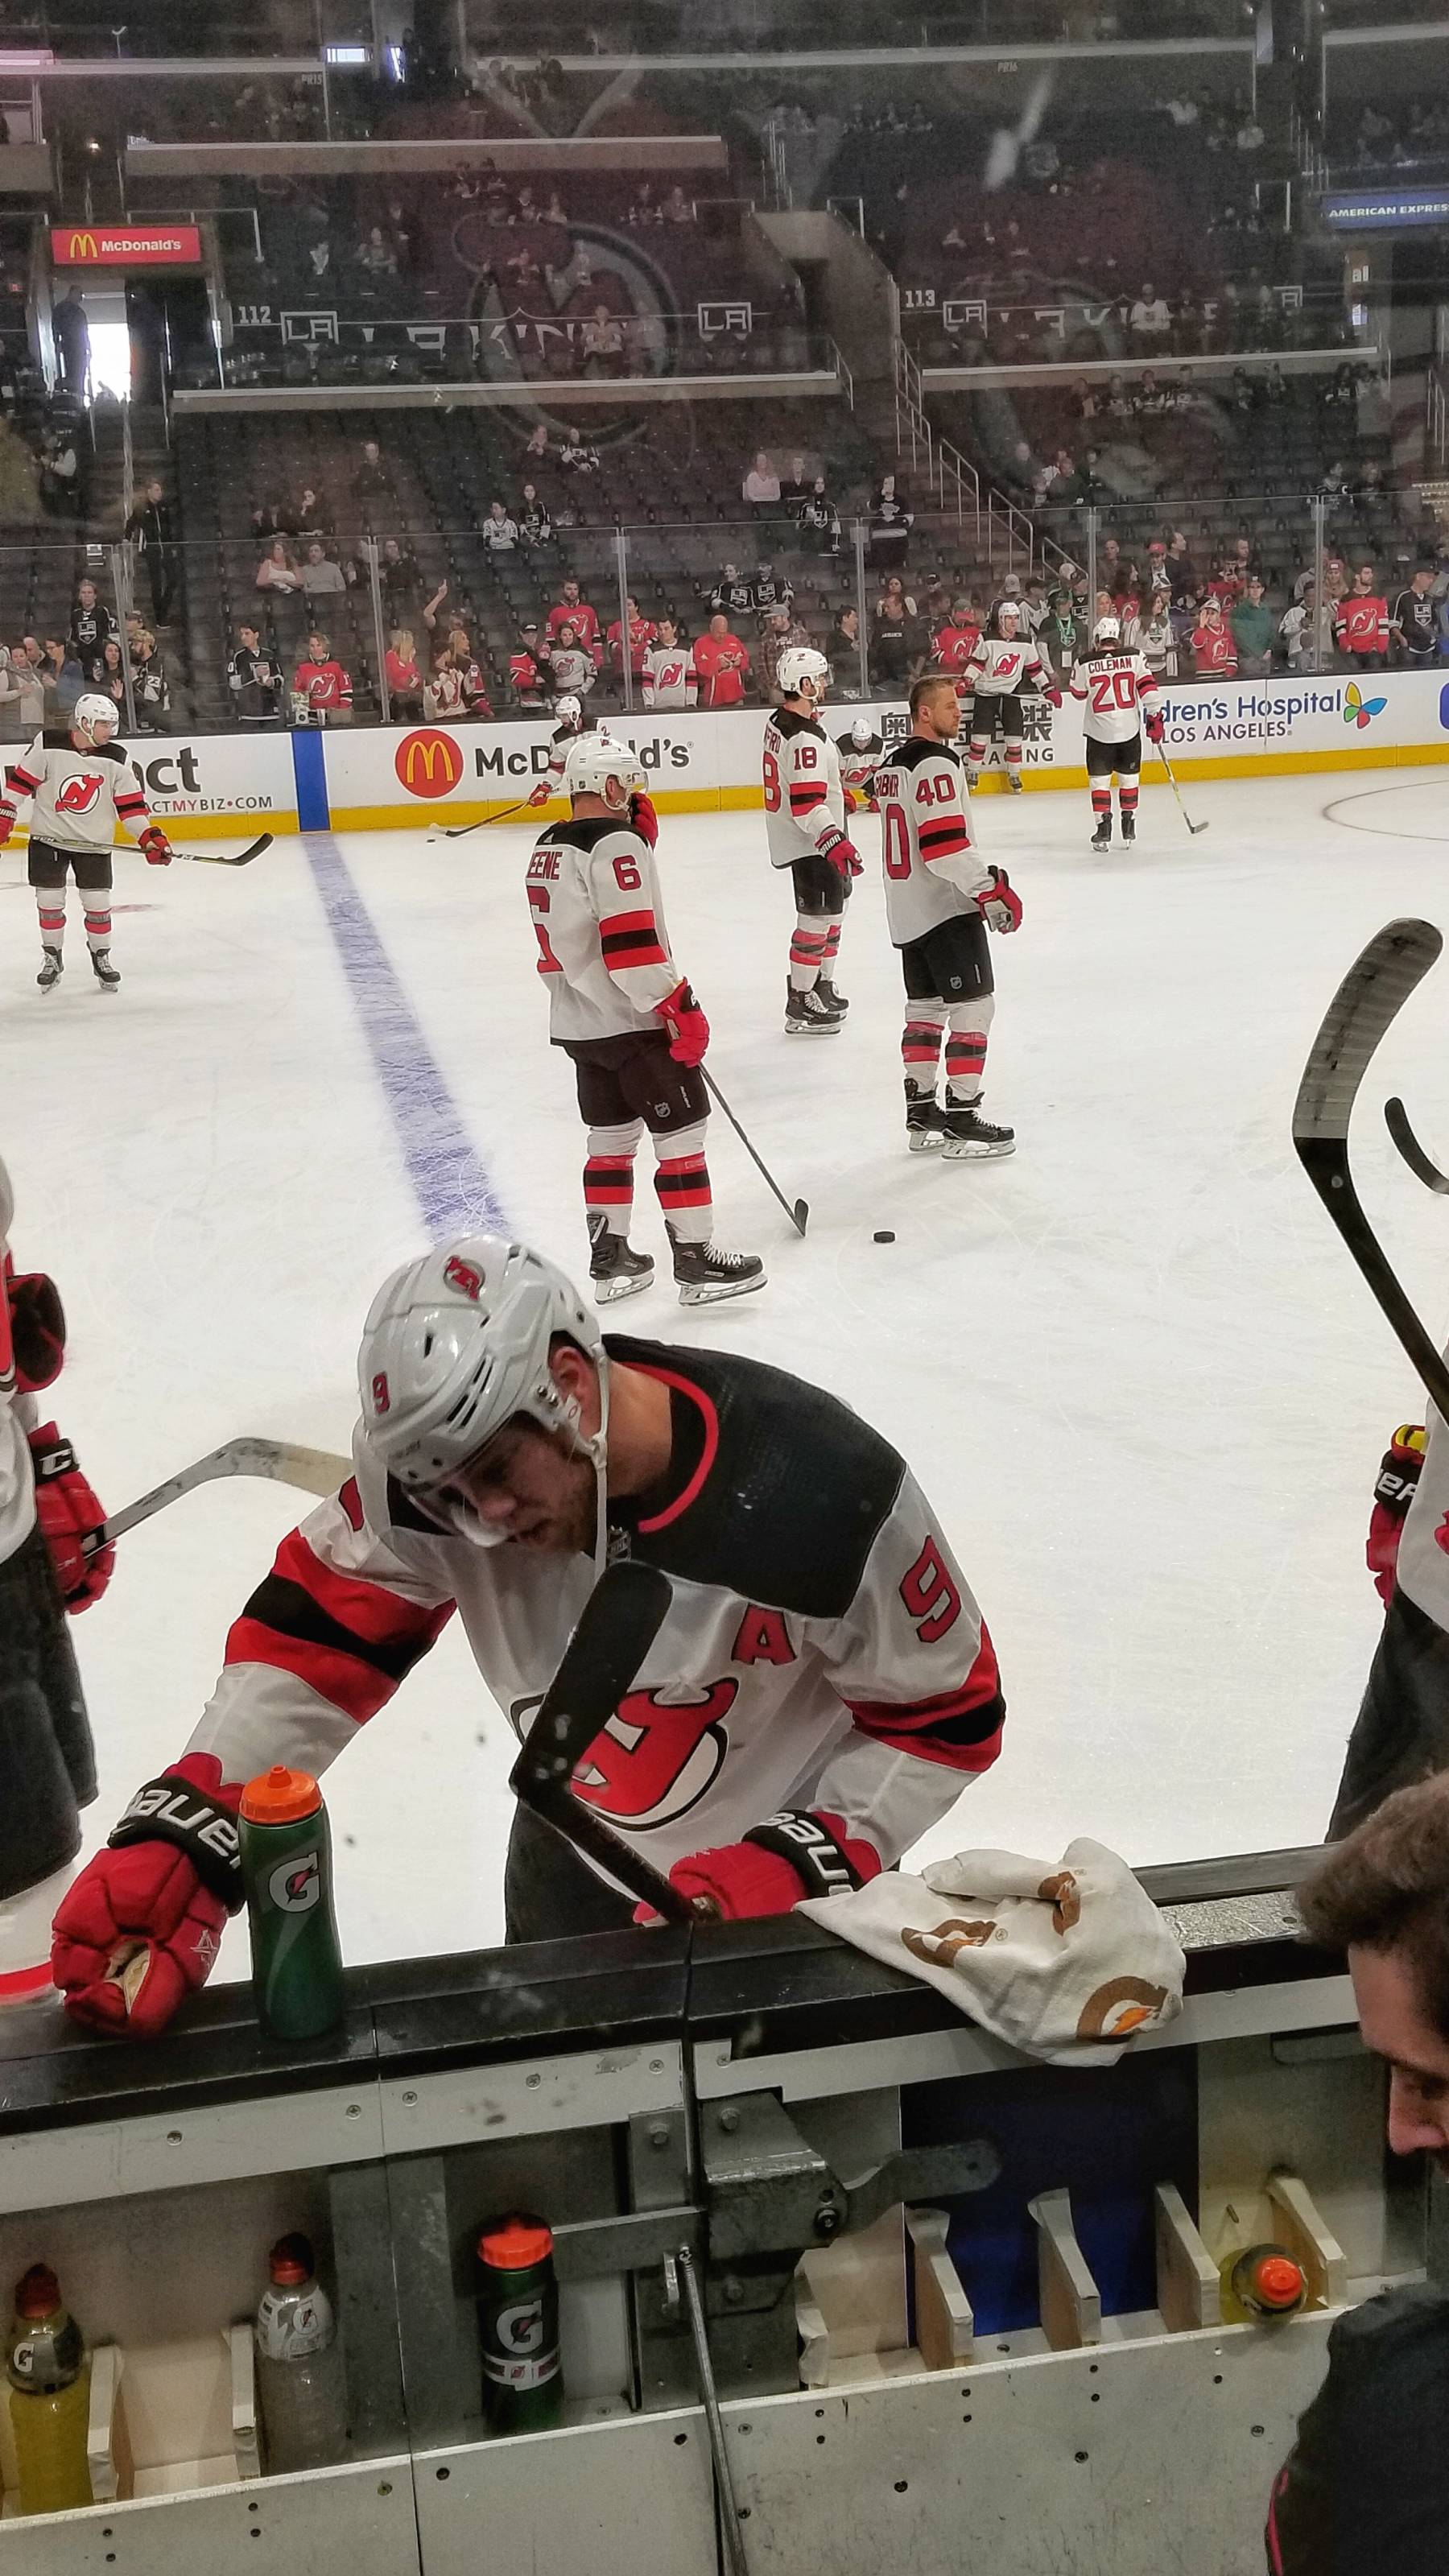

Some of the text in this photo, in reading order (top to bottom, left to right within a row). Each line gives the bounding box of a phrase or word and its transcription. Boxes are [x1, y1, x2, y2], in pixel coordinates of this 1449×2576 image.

[1329, 203, 1449, 218] AMERICAN EXPRES
[101, 239, 181, 252] McDonald's
[238, 306, 271, 324] 112
[905, 290, 935, 308] 113
[147, 675, 160, 687] 23
[1088, 657, 1133, 675] COLEMAN
[1088, 671, 1137, 714] 20
[1238, 688, 1340, 724] Hospital
[1162, 721, 1286, 744] LOS ANGELES
[794, 746, 817, 770] 18
[915, 773, 956, 807] 40
[612, 854, 642, 892] 6
[372, 1372, 390, 1414] 9
[899, 1534, 962, 1644] 9
[731, 1604, 797, 1666] A
[269, 1852, 320, 1913] G
[496, 2299, 544, 2355] G
